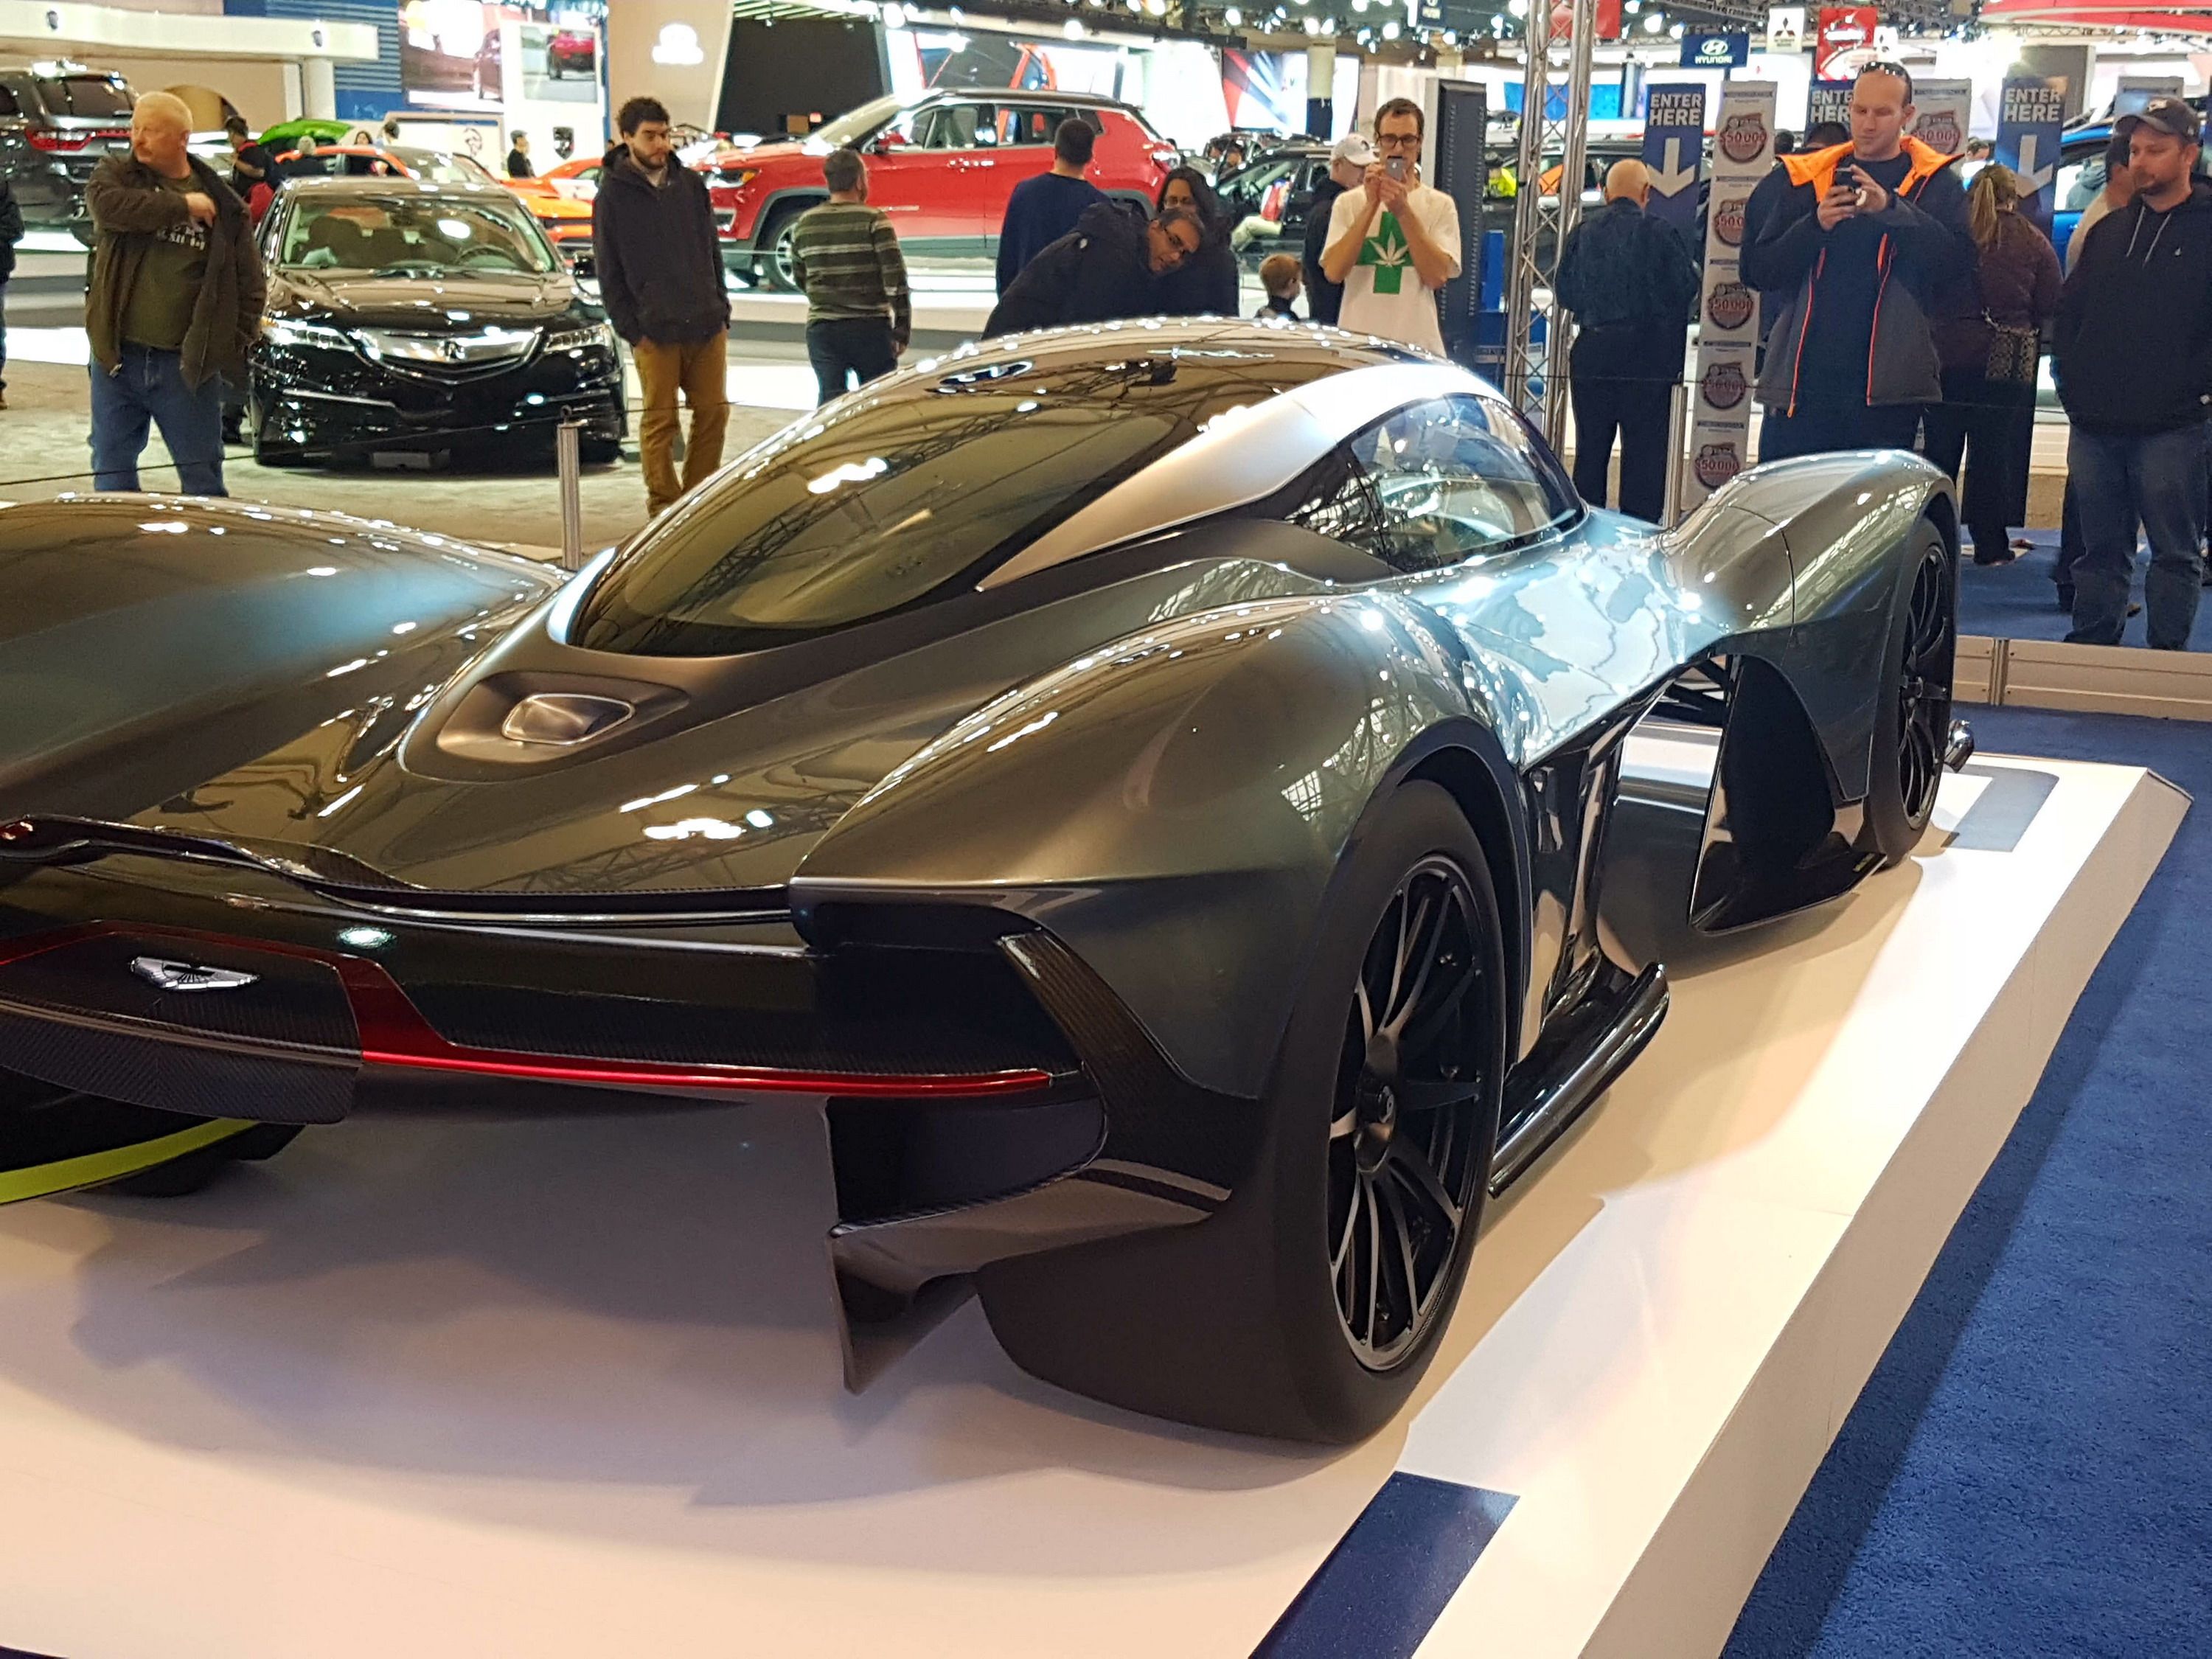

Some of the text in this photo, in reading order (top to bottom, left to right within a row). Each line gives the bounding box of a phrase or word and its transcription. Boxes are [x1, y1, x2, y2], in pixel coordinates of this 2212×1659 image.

[1694, 55, 1733, 65] HYUNDAI
[1650, 93, 1703, 108] ENTER
[1812, 89, 1854, 104] ENTE
[2005, 88, 2061, 102] ENTER
[1649, 108, 1701, 127] HERE
[1809, 105, 1852, 123] HER
[2003, 103, 2061, 122] HERE
